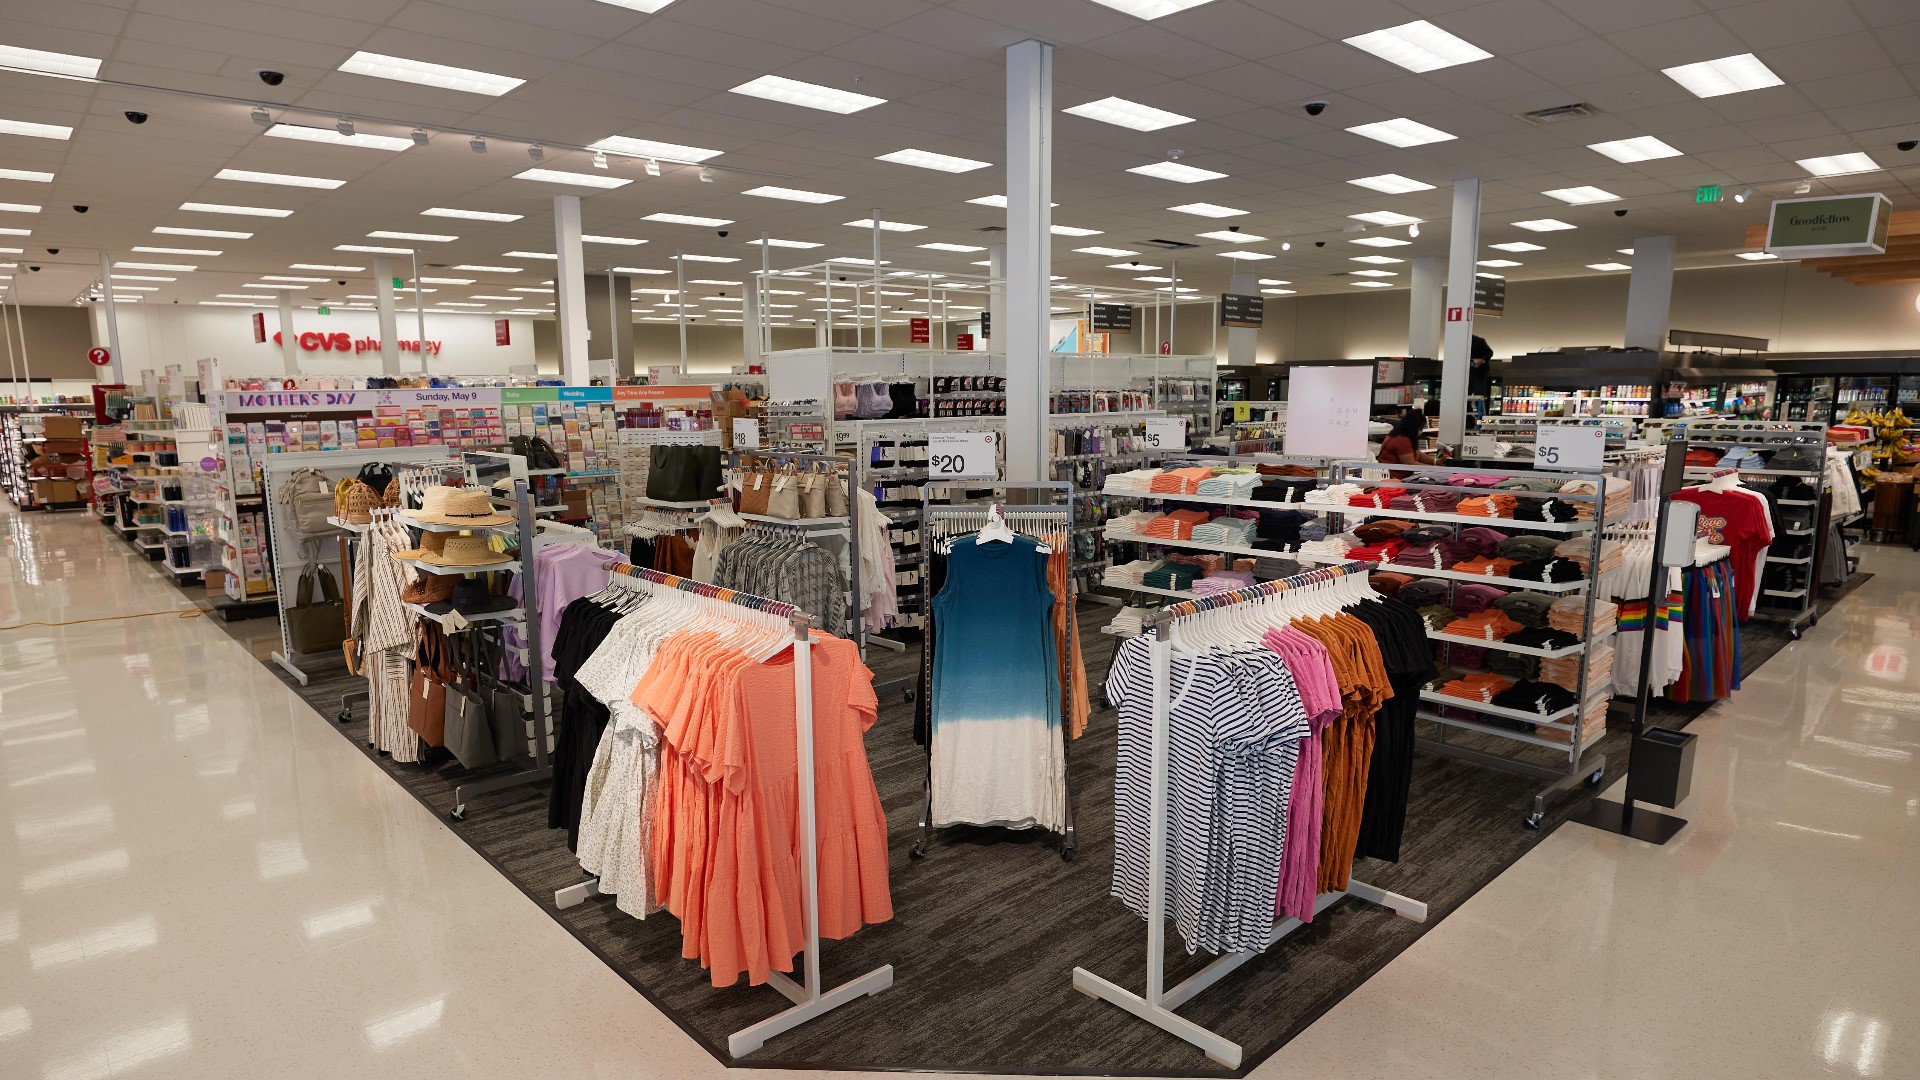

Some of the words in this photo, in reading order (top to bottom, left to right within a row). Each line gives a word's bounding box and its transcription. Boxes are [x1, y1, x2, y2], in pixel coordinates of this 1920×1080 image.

[1696, 186, 1720, 203] EXIT
[1789, 214, 1852, 226] Goodfellow
[300, 332, 352, 351] CVS
[355, 336, 442, 355] phamacy
[239, 392, 321, 407] MOTHER'S
[326, 392, 356, 405] DAY
[416, 392, 450, 401] Sunday,
[452, 392, 470, 401] May
[734, 432, 746, 445] $18
[1147, 433, 1160, 447] $5
[1463, 445, 1478, 456] $16
[1538, 445, 1560, 464] $5
[931, 454, 965, 473] $20
